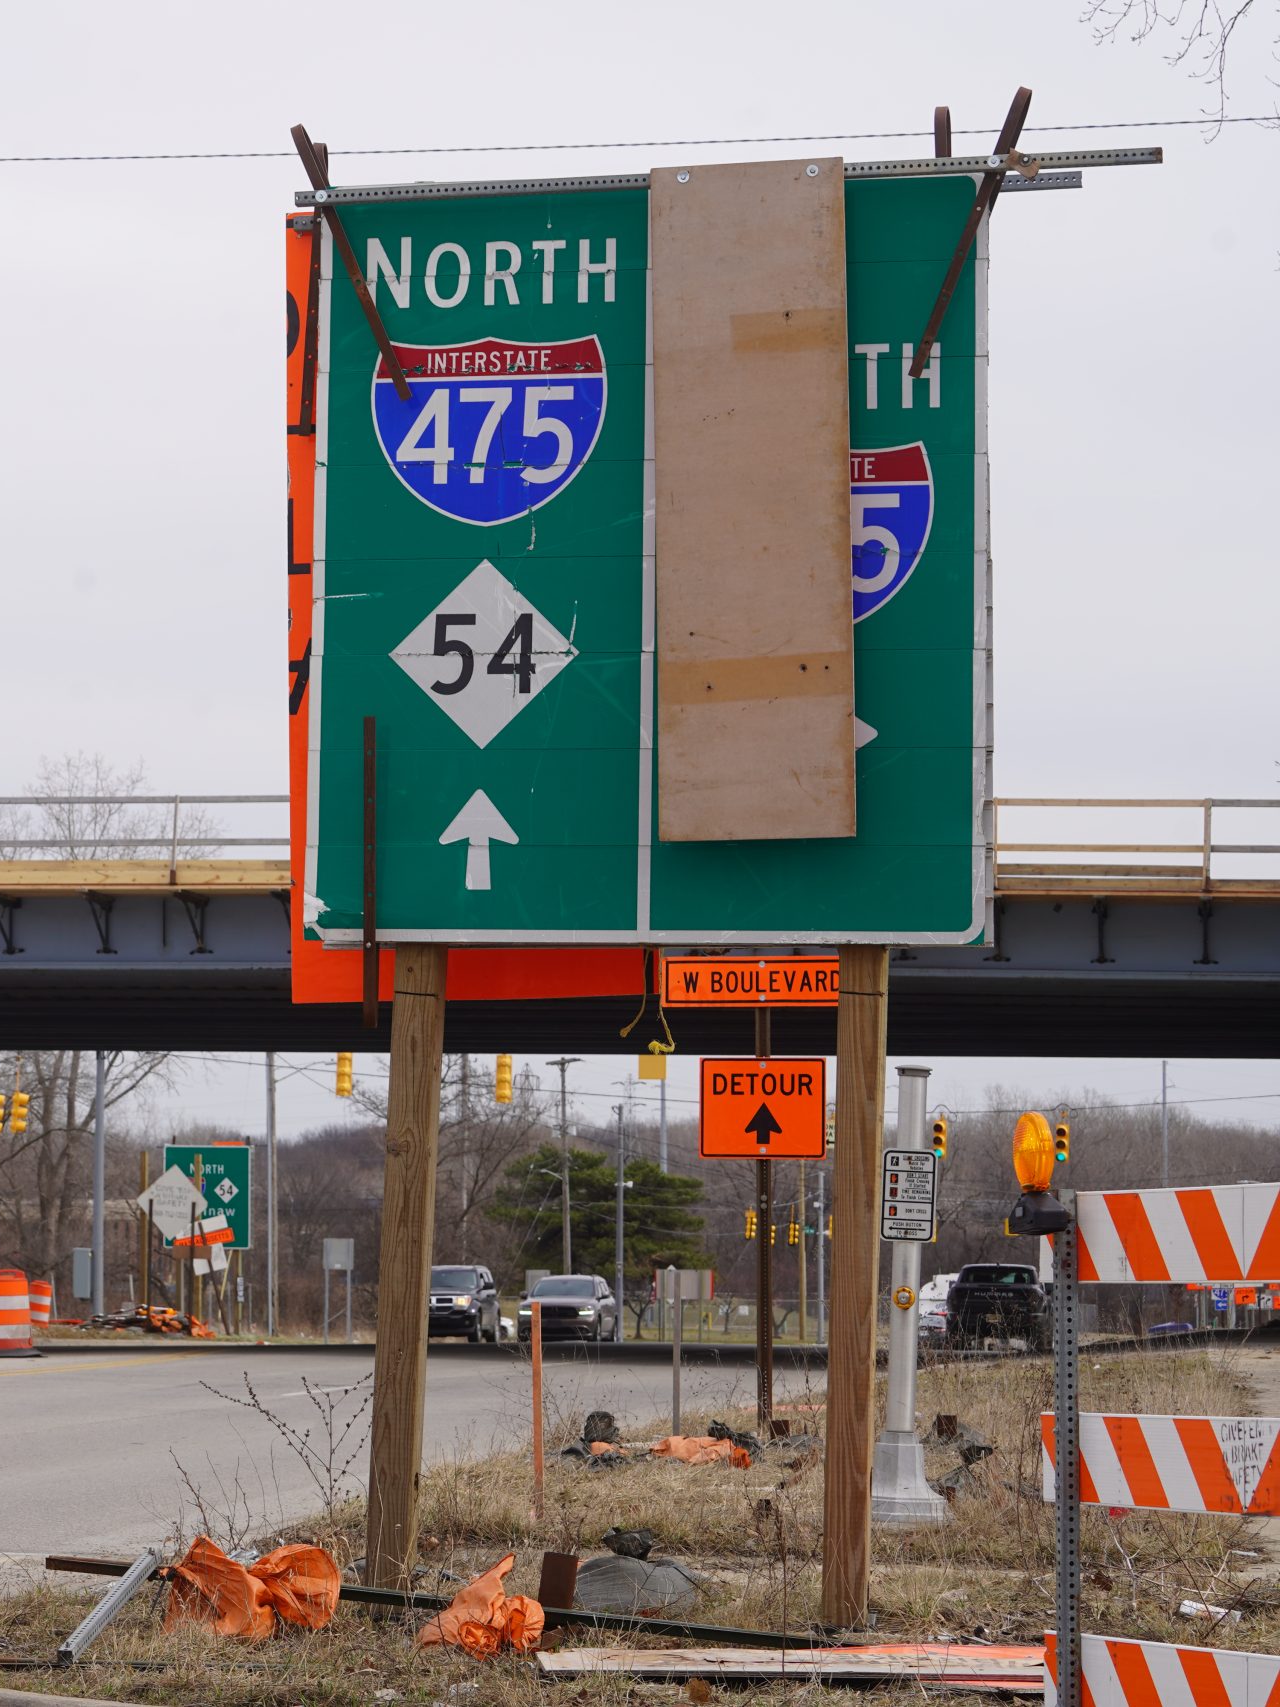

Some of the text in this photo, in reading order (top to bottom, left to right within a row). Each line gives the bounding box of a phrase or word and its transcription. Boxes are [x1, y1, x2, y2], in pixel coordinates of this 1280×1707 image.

[366, 236, 617, 309] NORTH
[427, 350, 551, 374] INTERSTATE
[396, 386, 574, 485] 475
[430, 613, 536, 696] 54
[683, 970, 839, 993] W BOULEVARD
[713, 1073, 813, 1096] DETOUR
[219, 1184, 233, 1196] 54
[203, 1207, 235, 1217] inaw
